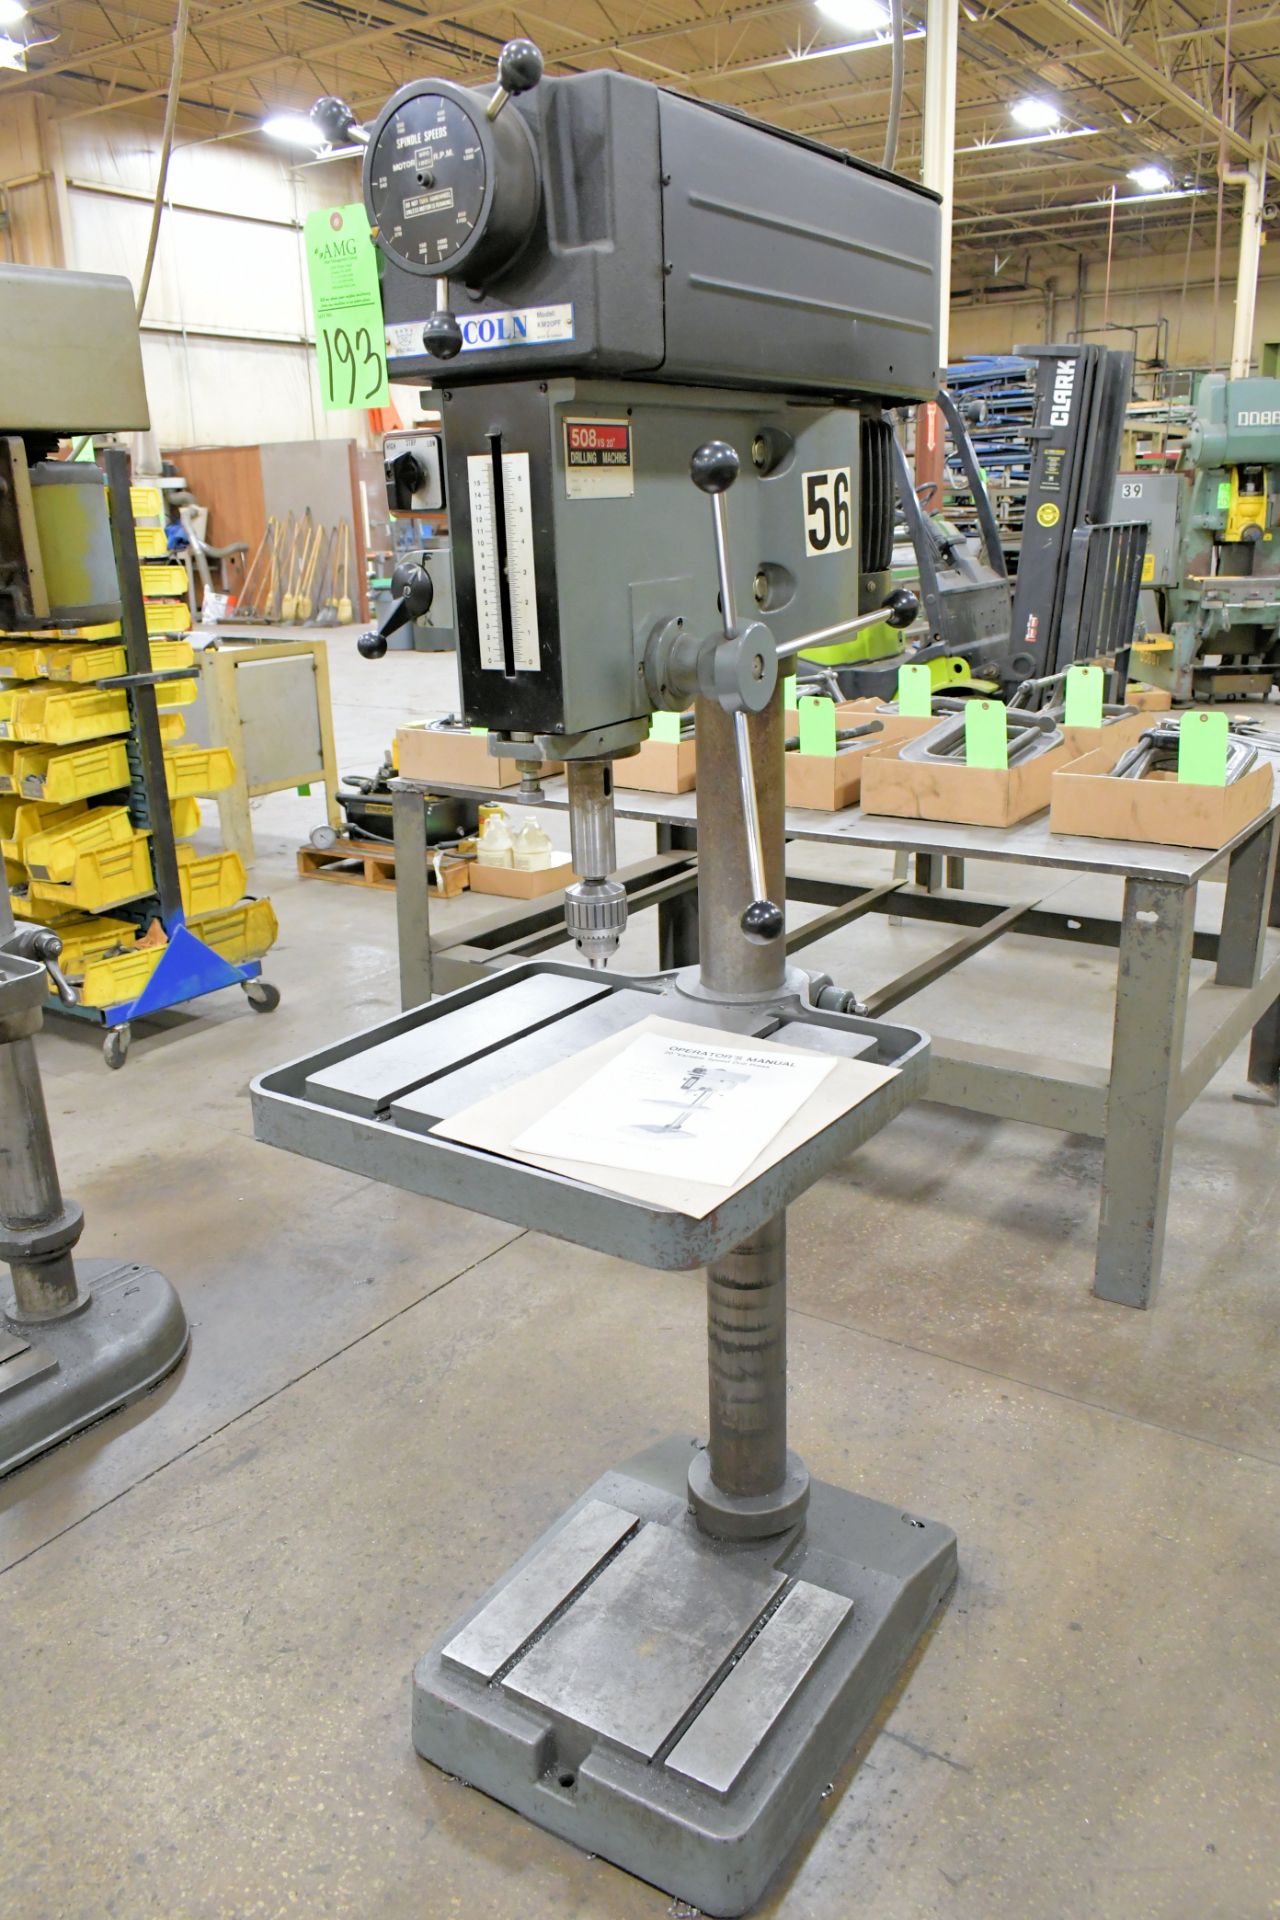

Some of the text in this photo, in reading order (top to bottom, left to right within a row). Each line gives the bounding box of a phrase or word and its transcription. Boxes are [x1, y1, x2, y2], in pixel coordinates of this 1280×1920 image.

[396, 132, 422, 149] SPINDLE
[424, 126, 447, 142] SPEEDS
[392, 160, 415, 172] MOTOR
[324, 238, 356, 259] AMG
[458, 315, 526, 344] COLN
[323, 328, 382, 404] 193
[1050, 360, 1076, 426] CLARK
[572, 428, 596, 448] 508
[571, 452, 628, 464] DRILLING MACHINE
[1123, 485, 1141, 497] 39
[807, 472, 850, 550] 56
[668, 1046, 796, 1068] OPERATOR'S MANUAL
